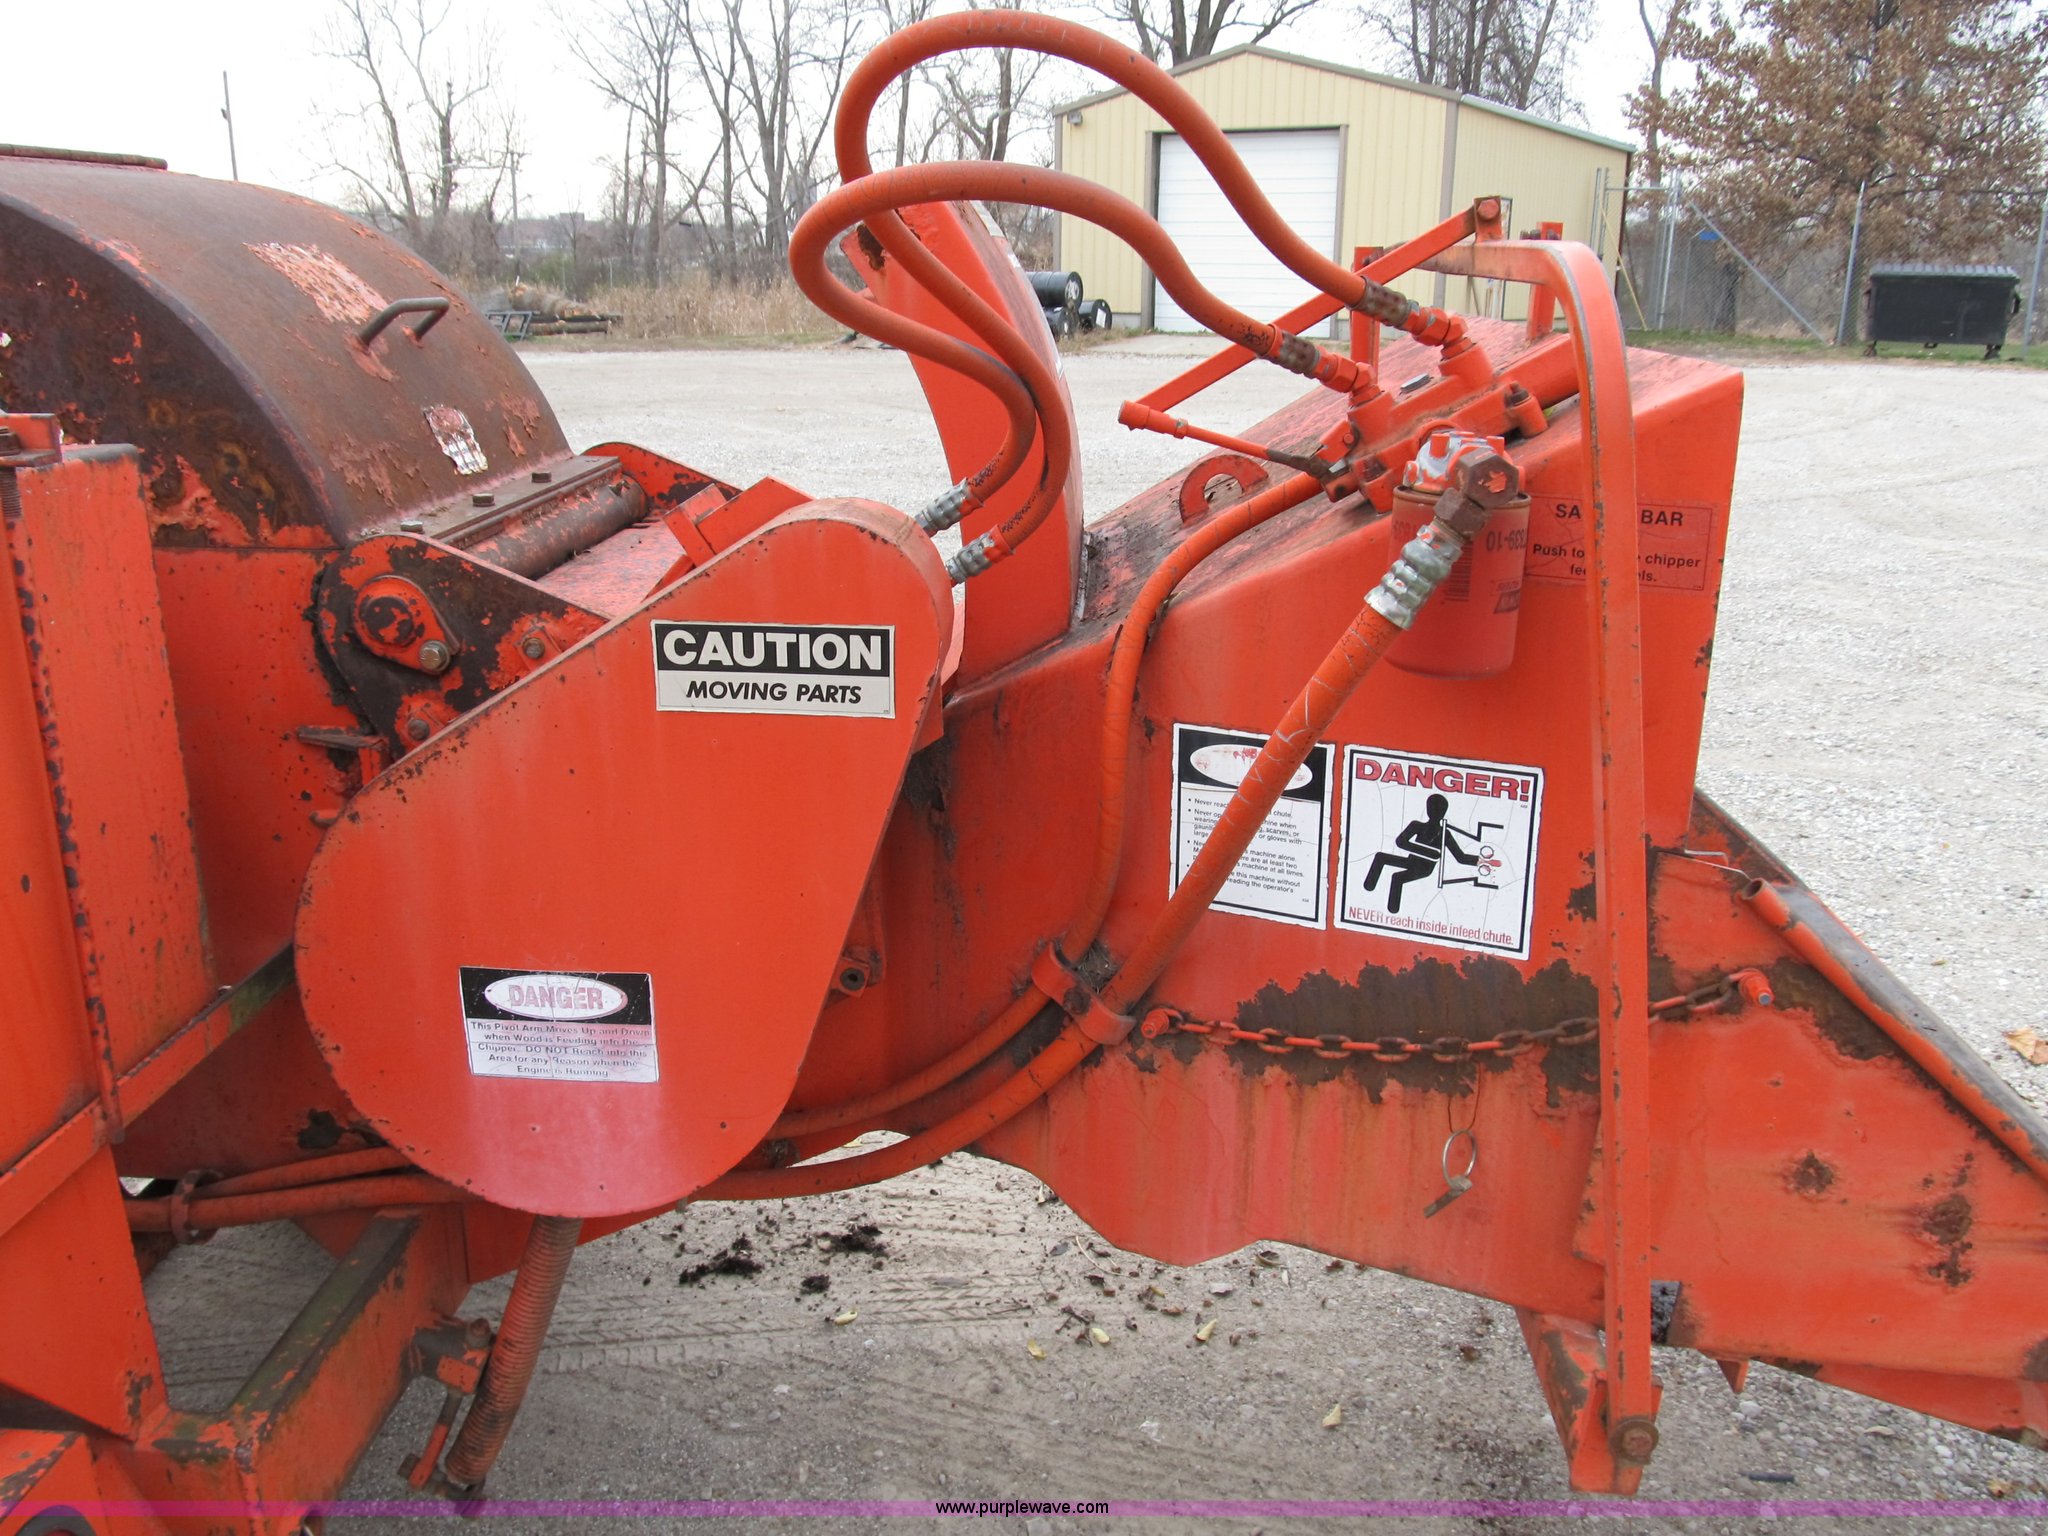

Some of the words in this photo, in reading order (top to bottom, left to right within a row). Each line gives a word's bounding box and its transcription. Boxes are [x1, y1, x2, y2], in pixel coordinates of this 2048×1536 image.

[1641, 510, 1684, 526] BAR
[1533, 544, 1567, 557] Push
[1645, 553, 1701, 568] chipper
[662, 629, 882, 671] CAUTION
[686, 680, 788, 701] MOVING
[796, 684, 862, 704] PARTS
[1355, 758, 1531, 802] DANGER!
[1194, 798, 1212, 806] Never
[1194, 808, 1212, 816] Never
[1267, 835, 1287, 843] gloves
[1250, 850, 1276, 858] machine
[1242, 862, 1268, 871] machine
[1249, 874, 1276, 883] machine
[1277, 878, 1301, 888] without
[1263, 883, 1294, 893] operator's
[1349, 906, 1384, 924] NEVER
[1385, 915, 1413, 929] reach
[1416, 917, 1448, 934] inside
[1449, 924, 1481, 939] infeed
[1483, 929, 1514, 945] chute.
[508, 984, 604, 1010] DANGER
[471, 1021, 492, 1030] This
[495, 1023, 519, 1031] Pivot
[546, 1026, 578, 1034] Moves
[582, 1027, 596, 1035] Up
[513, 1034, 541, 1042] Wood
[557, 1036, 597, 1046] Feeding
[526, 1045, 542, 1053] DO
[546, 1046, 567, 1054] NOT
[573, 1047, 604, 1056] Reach
[531, 1057, 549, 1065] any
[517, 1065, 551, 1074] Engine
